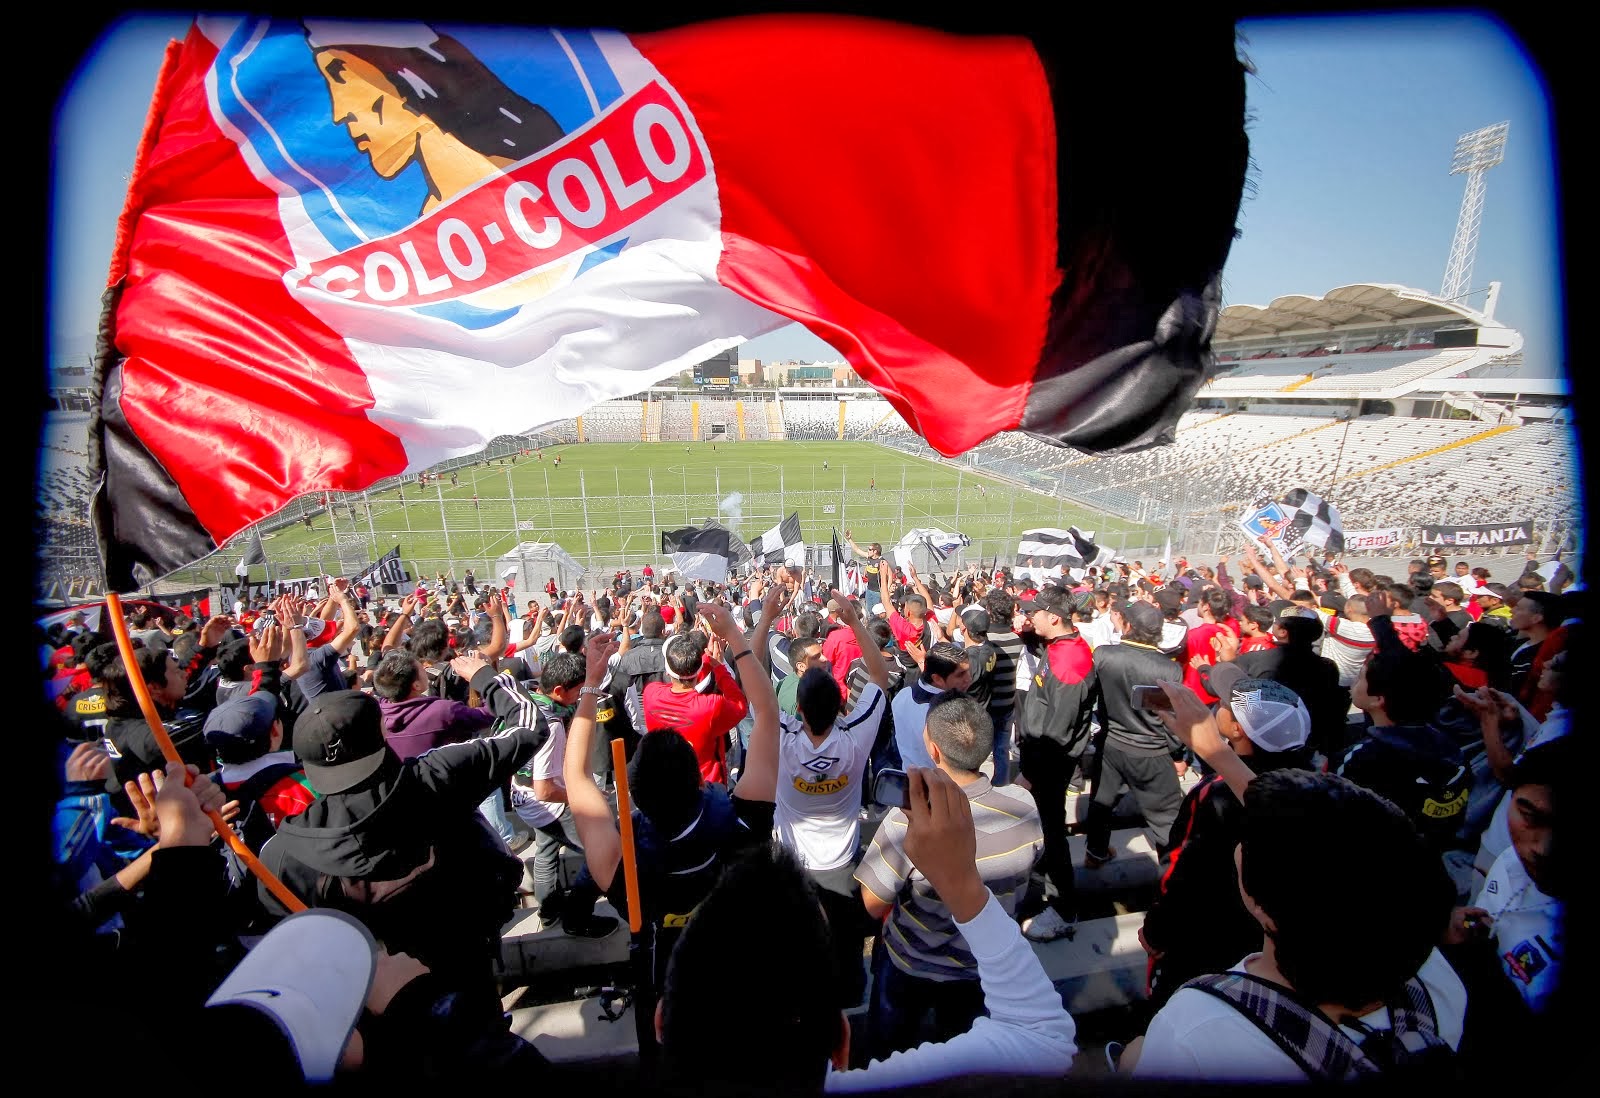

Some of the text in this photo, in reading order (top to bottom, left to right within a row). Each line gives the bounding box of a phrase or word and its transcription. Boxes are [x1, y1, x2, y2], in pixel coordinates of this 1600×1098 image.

[1422, 527, 1527, 545] LA GRANJA
[78, 702, 105, 711] CRISTA
[799, 781, 846, 793] CRISTAL
